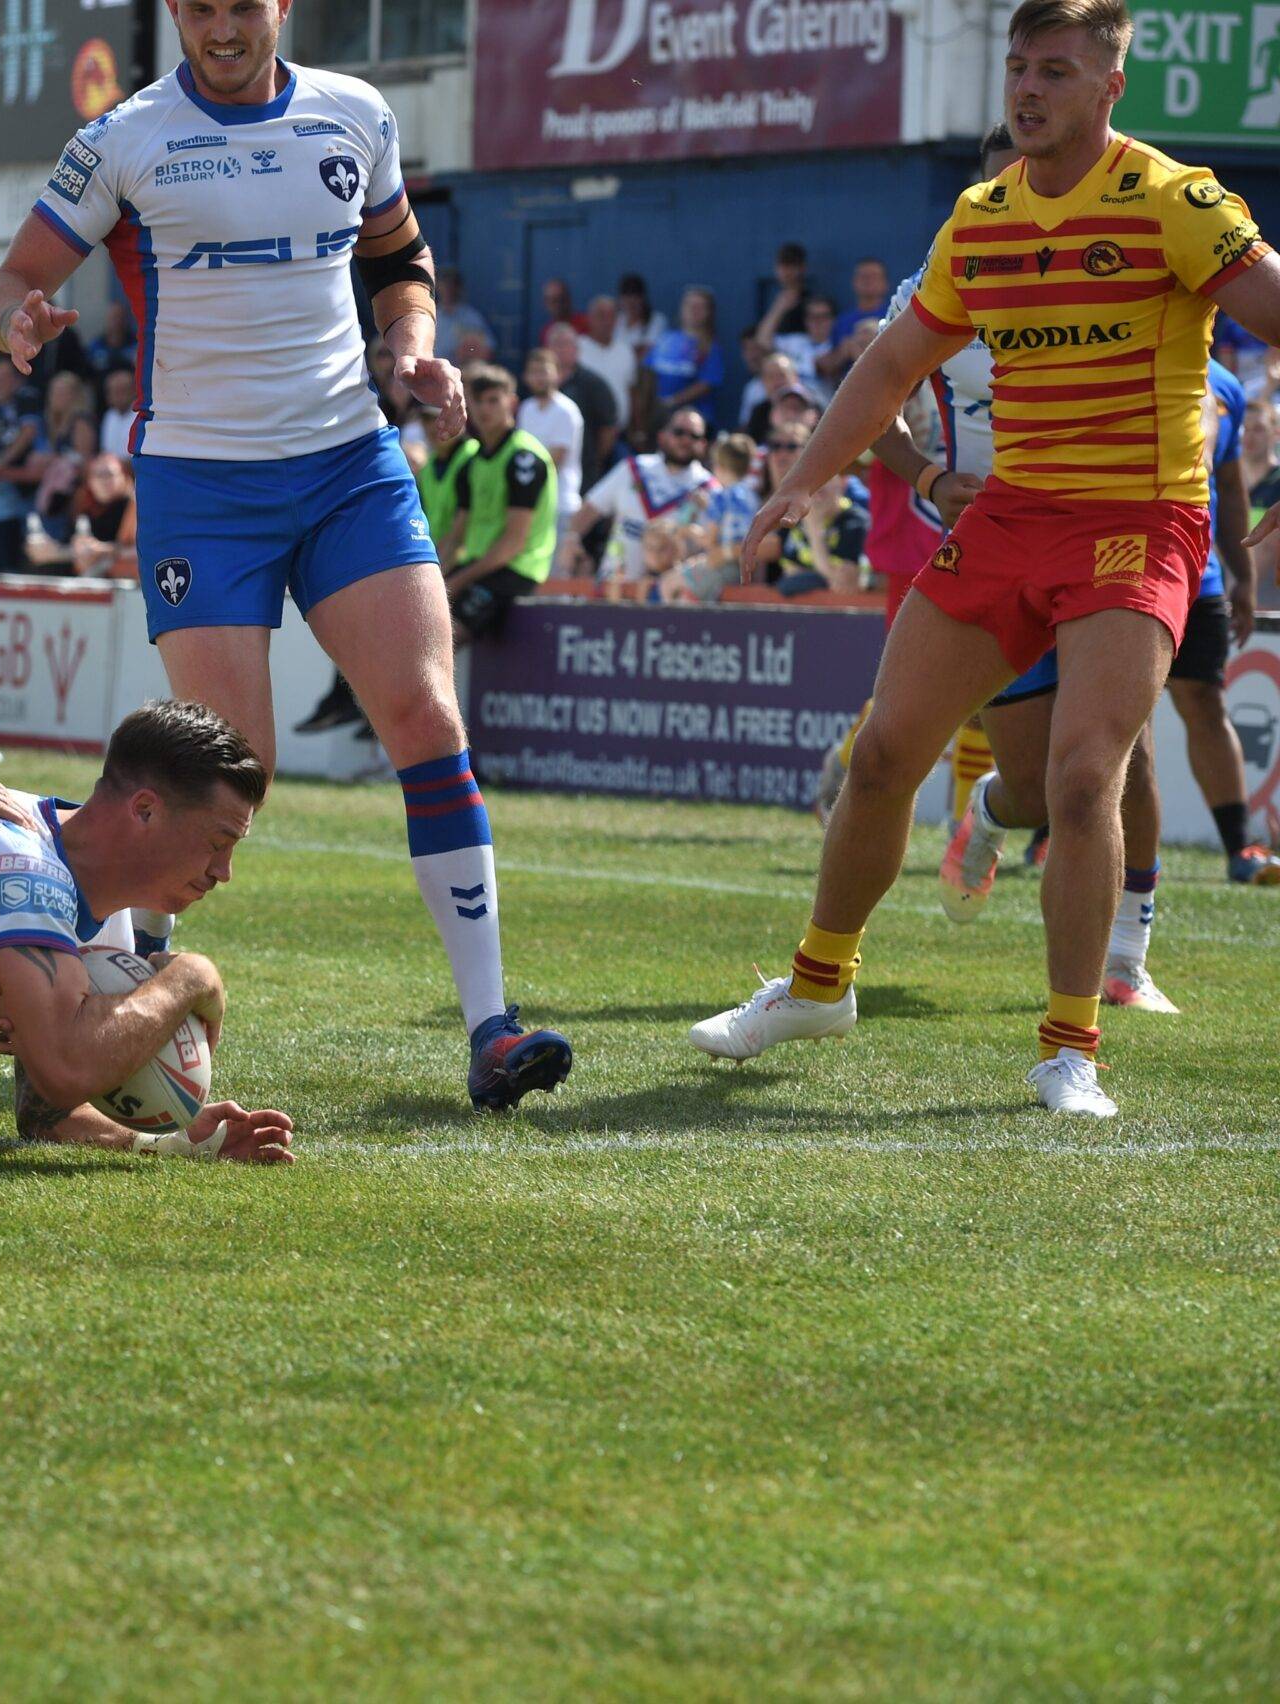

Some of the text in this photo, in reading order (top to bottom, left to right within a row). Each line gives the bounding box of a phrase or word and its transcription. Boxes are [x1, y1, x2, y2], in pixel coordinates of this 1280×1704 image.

[650, 4, 738, 64] Event
[745, 0, 890, 64] Catering
[1132, 10, 1242, 63] EXIT
[1165, 65, 1200, 117] D
[155, 159, 214, 177] BISTRO
[155, 171, 216, 187] HORBURY
[251, 165, 283, 176] hummel
[52, 171, 82, 198] EAGUE
[1100, 192, 1146, 205] Groupama
[992, 321, 1133, 350] ZODIAC
[557, 624, 795, 686] First 4 Fascias Ltd
[481, 691, 574, 732] CONTACT
[576, 696, 607, 734] US
[607, 698, 663, 737] NOW
[666, 702, 710, 740] FOR
[709, 704, 730, 742] A
[733, 706, 793, 746] FREE
